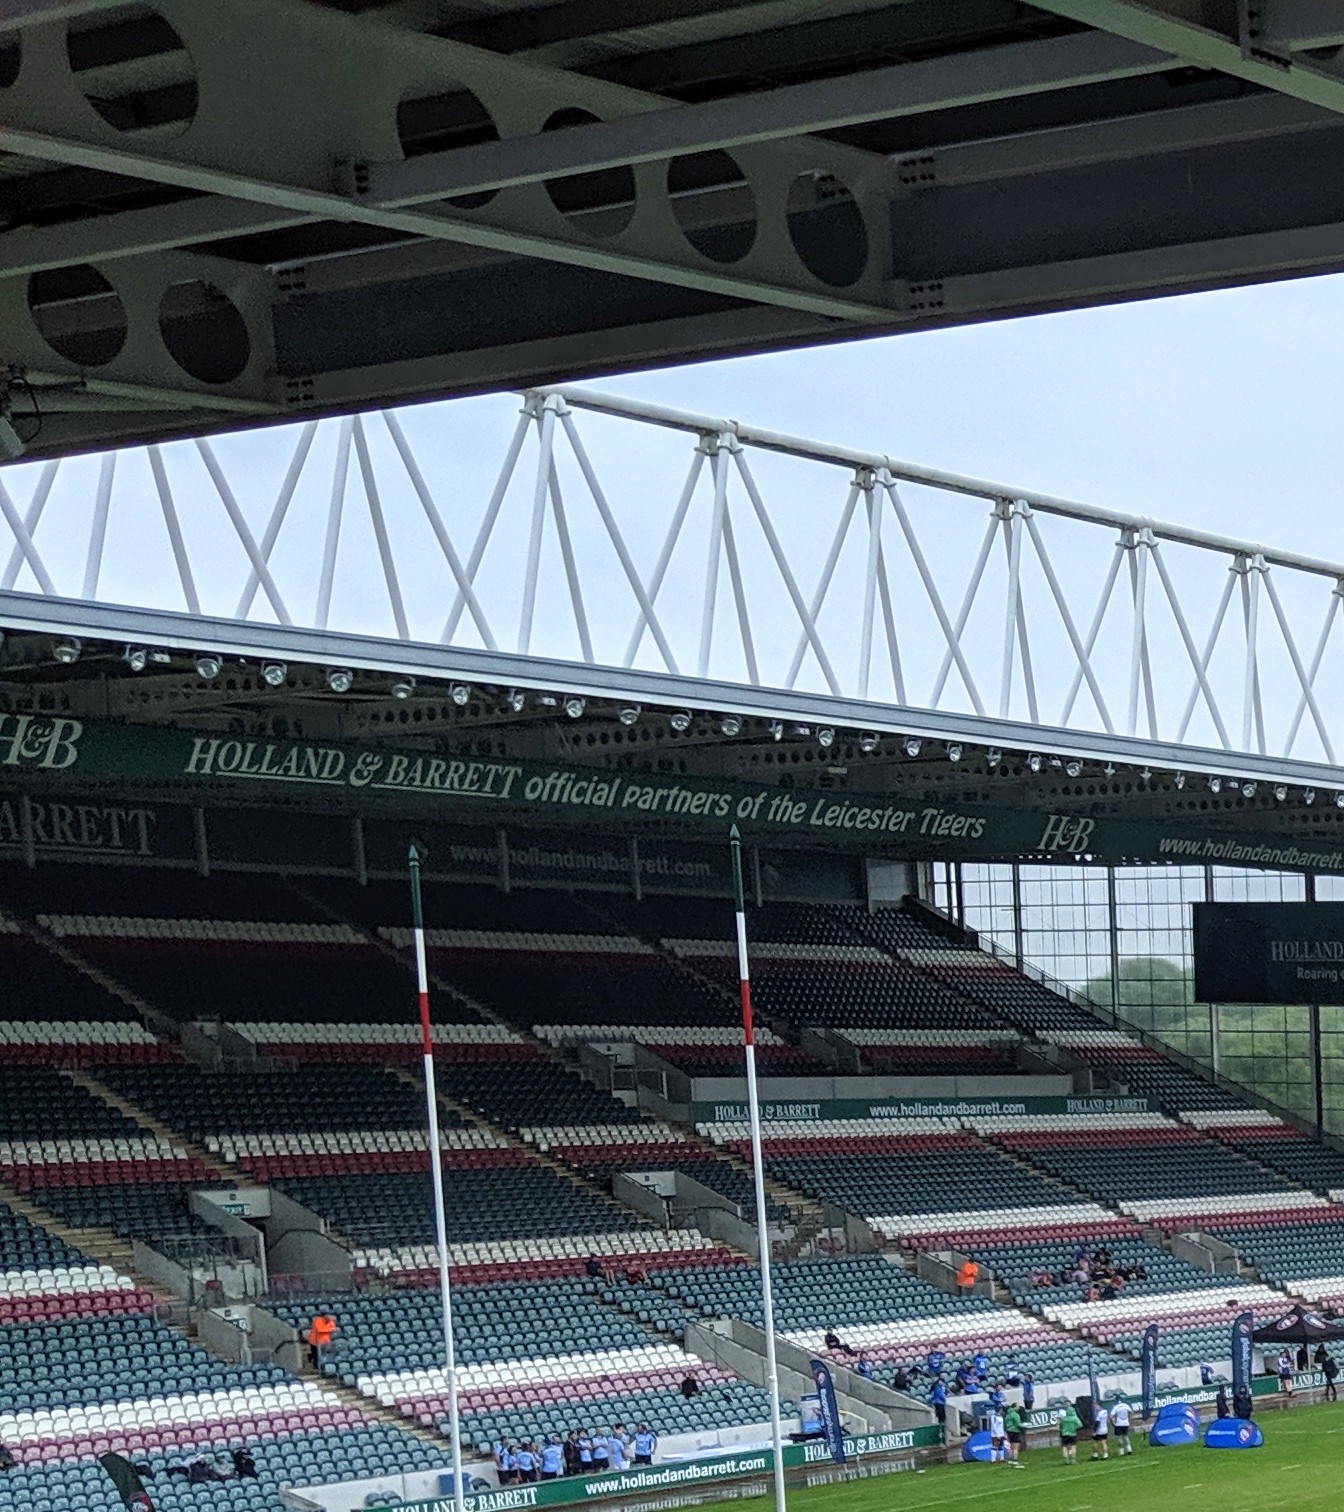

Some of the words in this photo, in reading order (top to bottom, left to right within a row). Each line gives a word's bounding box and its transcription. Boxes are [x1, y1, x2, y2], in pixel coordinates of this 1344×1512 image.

[184, 738, 346, 783] HOLLAND
[349, 752, 383, 787] &
[387, 753, 523, 799] BARRETT
[524, 772, 622, 808] official
[622, 784, 729, 818] partners
[737, 793, 764, 820] of
[767, 795, 808, 822] the
[809, 798, 915, 834] Leicester
[919, 808, 988, 840] Tigers
[1036, 814, 1098, 853] H&B
[1271, 941, 1344, 963] HOLLAND
[1296, 967, 1338, 984] Roaring
[776, 1104, 820, 1119] BARRETT
[869, 1101, 1026, 1118] www.hollandandbarrett.com
[868, 1431, 915, 1451] BARRETT
[584, 1456, 766, 1496] www.hollandandbarrett.com
[478, 1487, 538, 1511] BARRETT
